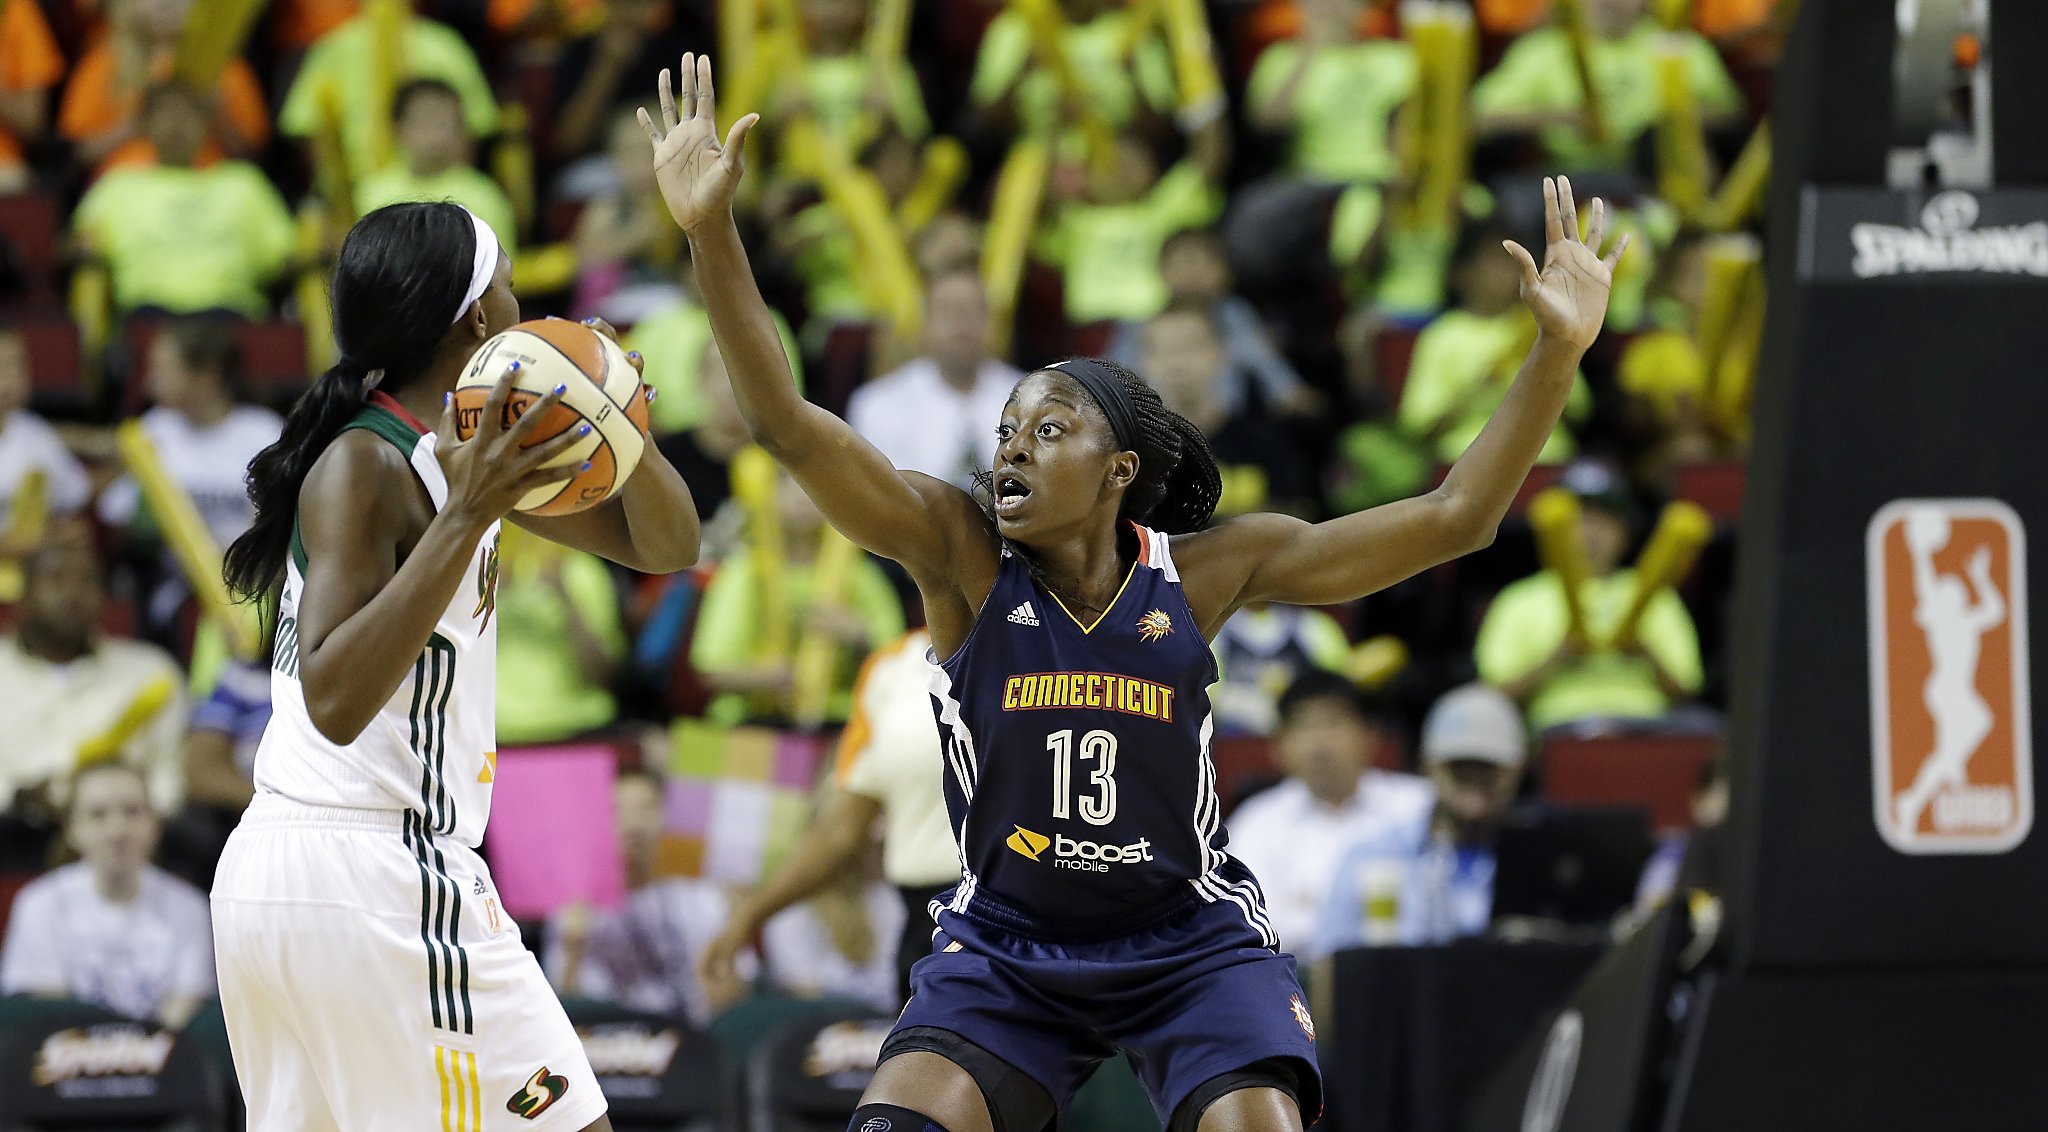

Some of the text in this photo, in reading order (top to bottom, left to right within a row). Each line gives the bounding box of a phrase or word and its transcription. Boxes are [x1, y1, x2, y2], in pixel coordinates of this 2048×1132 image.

[1007, 614, 1039, 627] adidas
[1002, 671, 1174, 723] CONNECTICUT
[1047, 729, 1118, 826] 13
[1055, 834, 1153, 864] boost
[1055, 859, 1109, 873] mobile
